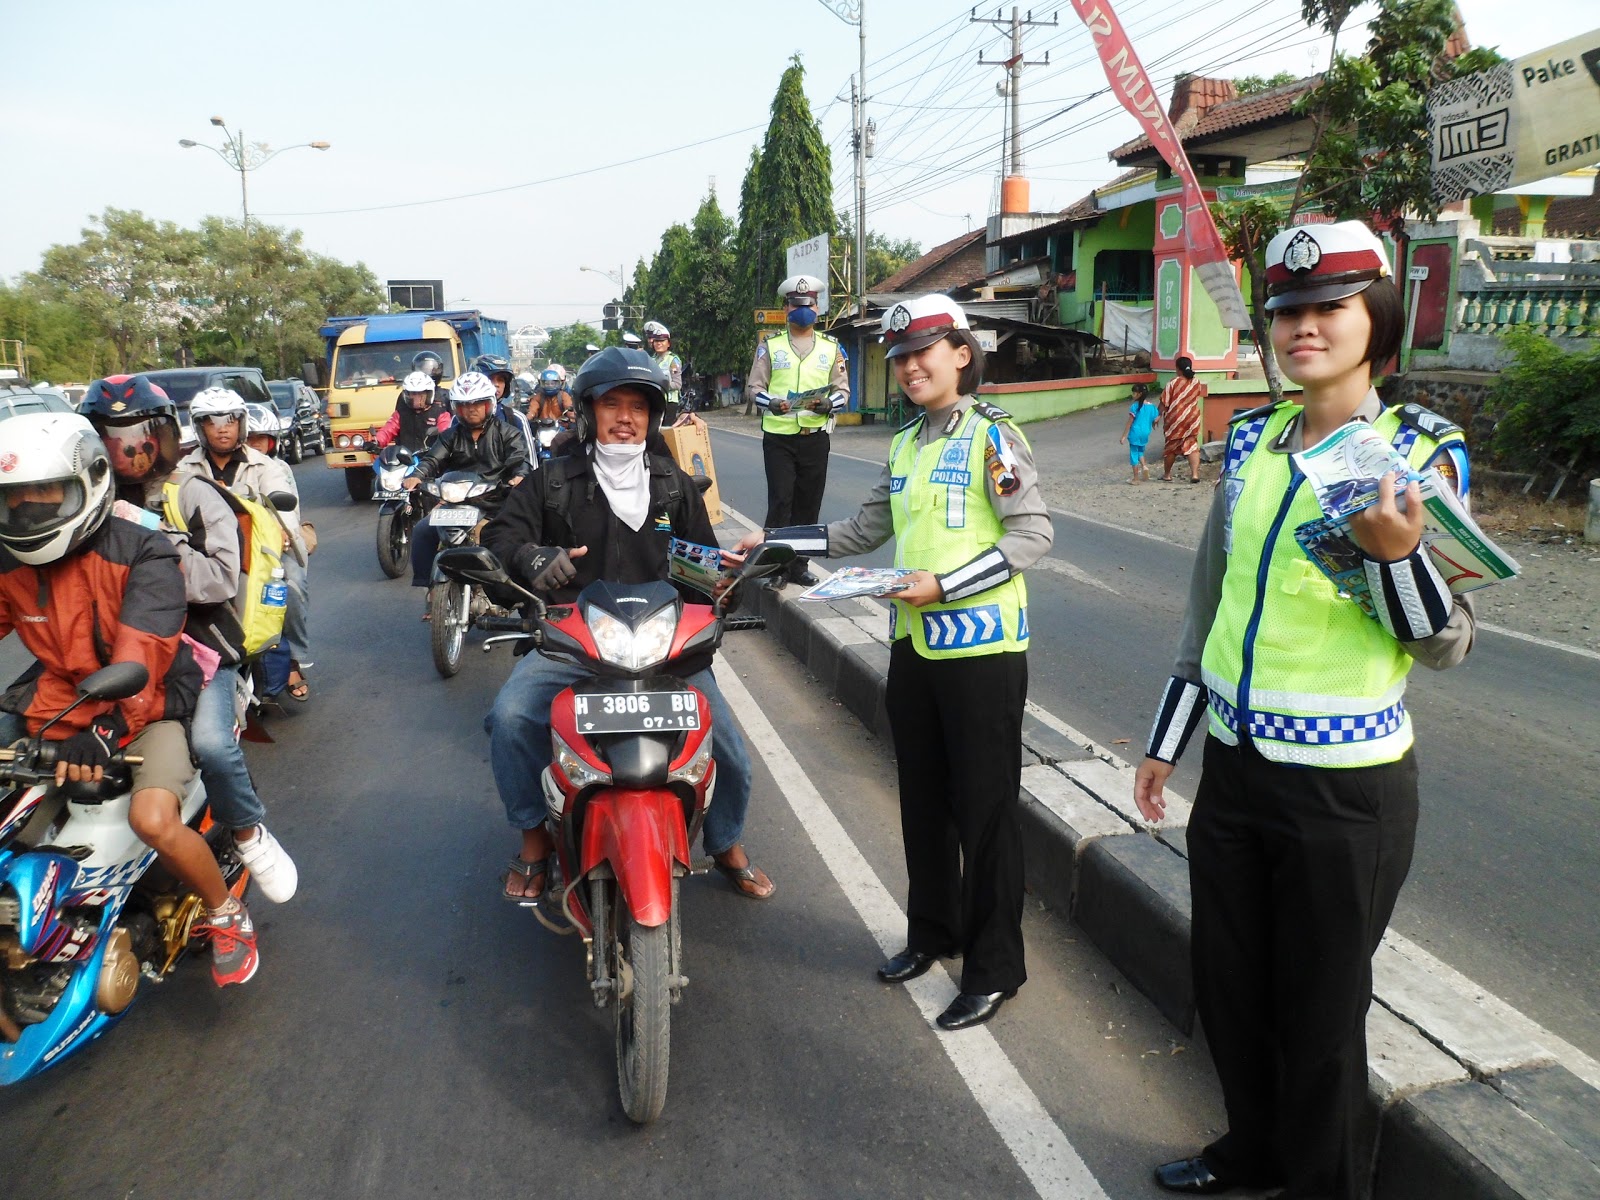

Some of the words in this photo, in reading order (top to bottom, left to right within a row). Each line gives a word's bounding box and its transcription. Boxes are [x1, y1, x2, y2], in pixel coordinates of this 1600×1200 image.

[1522, 58, 1577, 88] Pake
[1441, 110, 1470, 123] indosat
[793, 240, 820, 260] AIDS
[1166, 281, 1174, 294] 17
[1165, 296, 1171, 310] 8
[1161, 317, 1177, 330] 1945
[931, 470, 970, 486] POLISI
[576, 697, 589, 715] H
[602, 695, 651, 714] 3806
[671, 694, 696, 712] BU
[43, 1010, 96, 1062] SUZUKI
